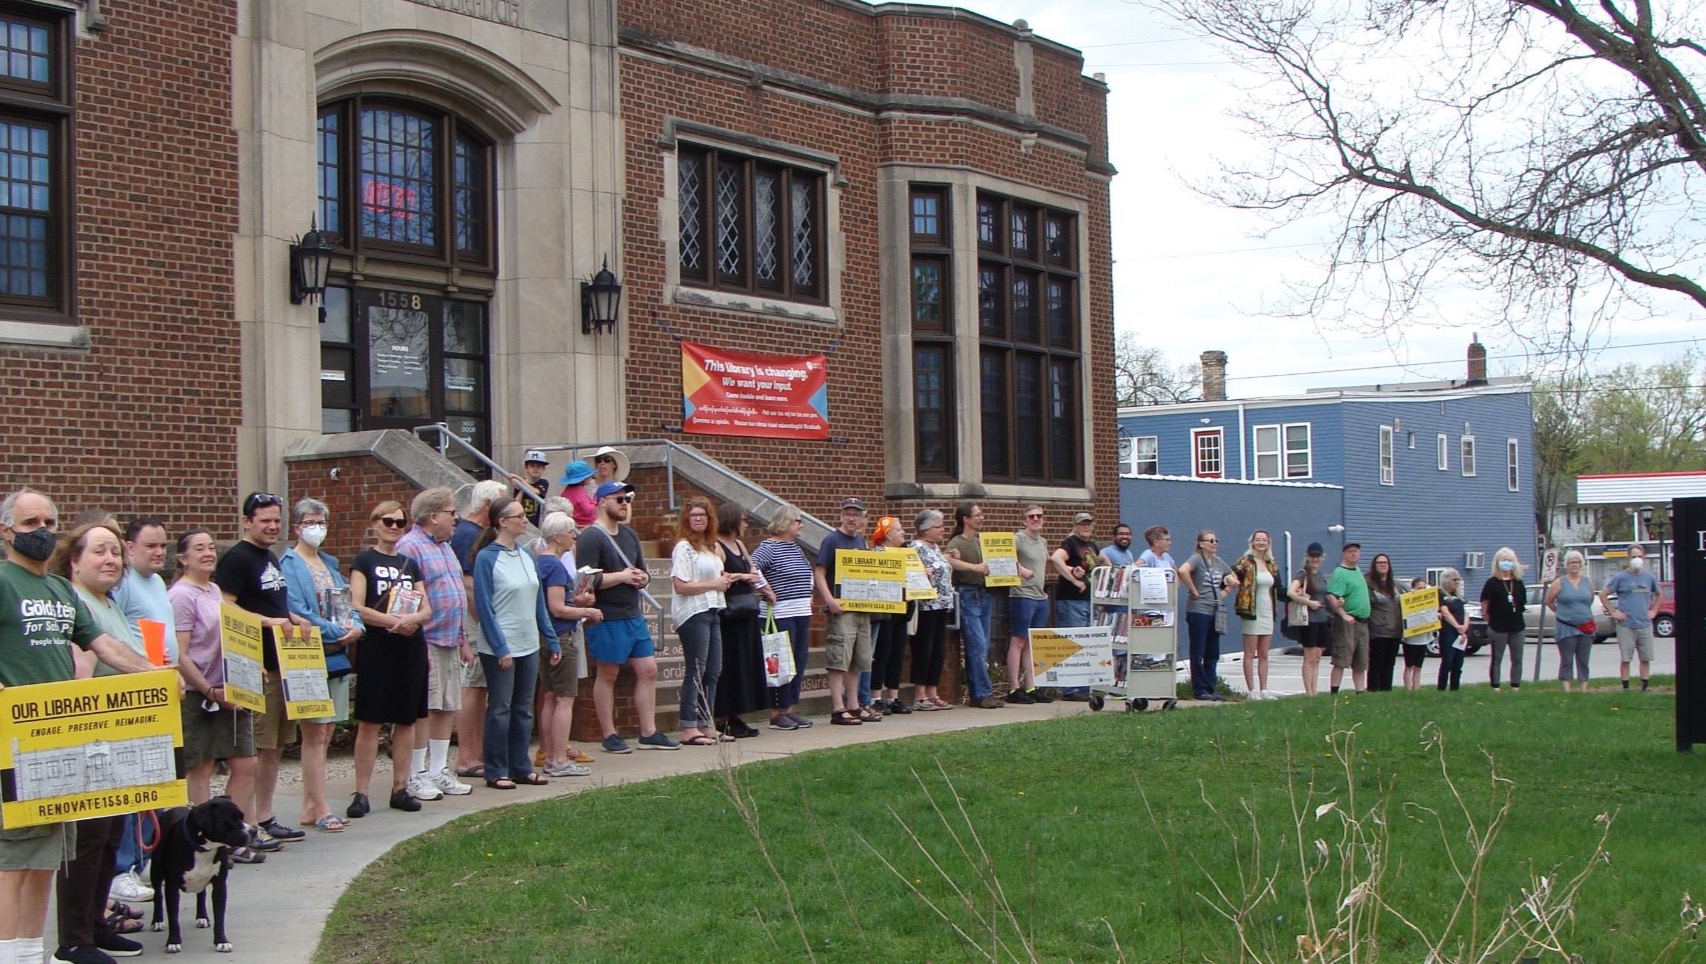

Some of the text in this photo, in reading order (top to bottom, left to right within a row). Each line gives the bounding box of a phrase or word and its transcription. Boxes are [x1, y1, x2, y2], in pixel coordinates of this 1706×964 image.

[379, 291, 421, 310] 1558
[704, 359, 808, 381] This library is changing.
[722, 377, 793, 392] We want your input.
[842, 556, 902, 567] OUR LIBRARY MATTERS
[24, 622, 43, 635] for
[12, 687, 168, 720] OUR LIBRARY MATTERS
[31, 715, 159, 737] ENGAGE. PRESERVE. REIMAGINE.
[39, 790, 158, 817] RENOVATE1558.ORG
